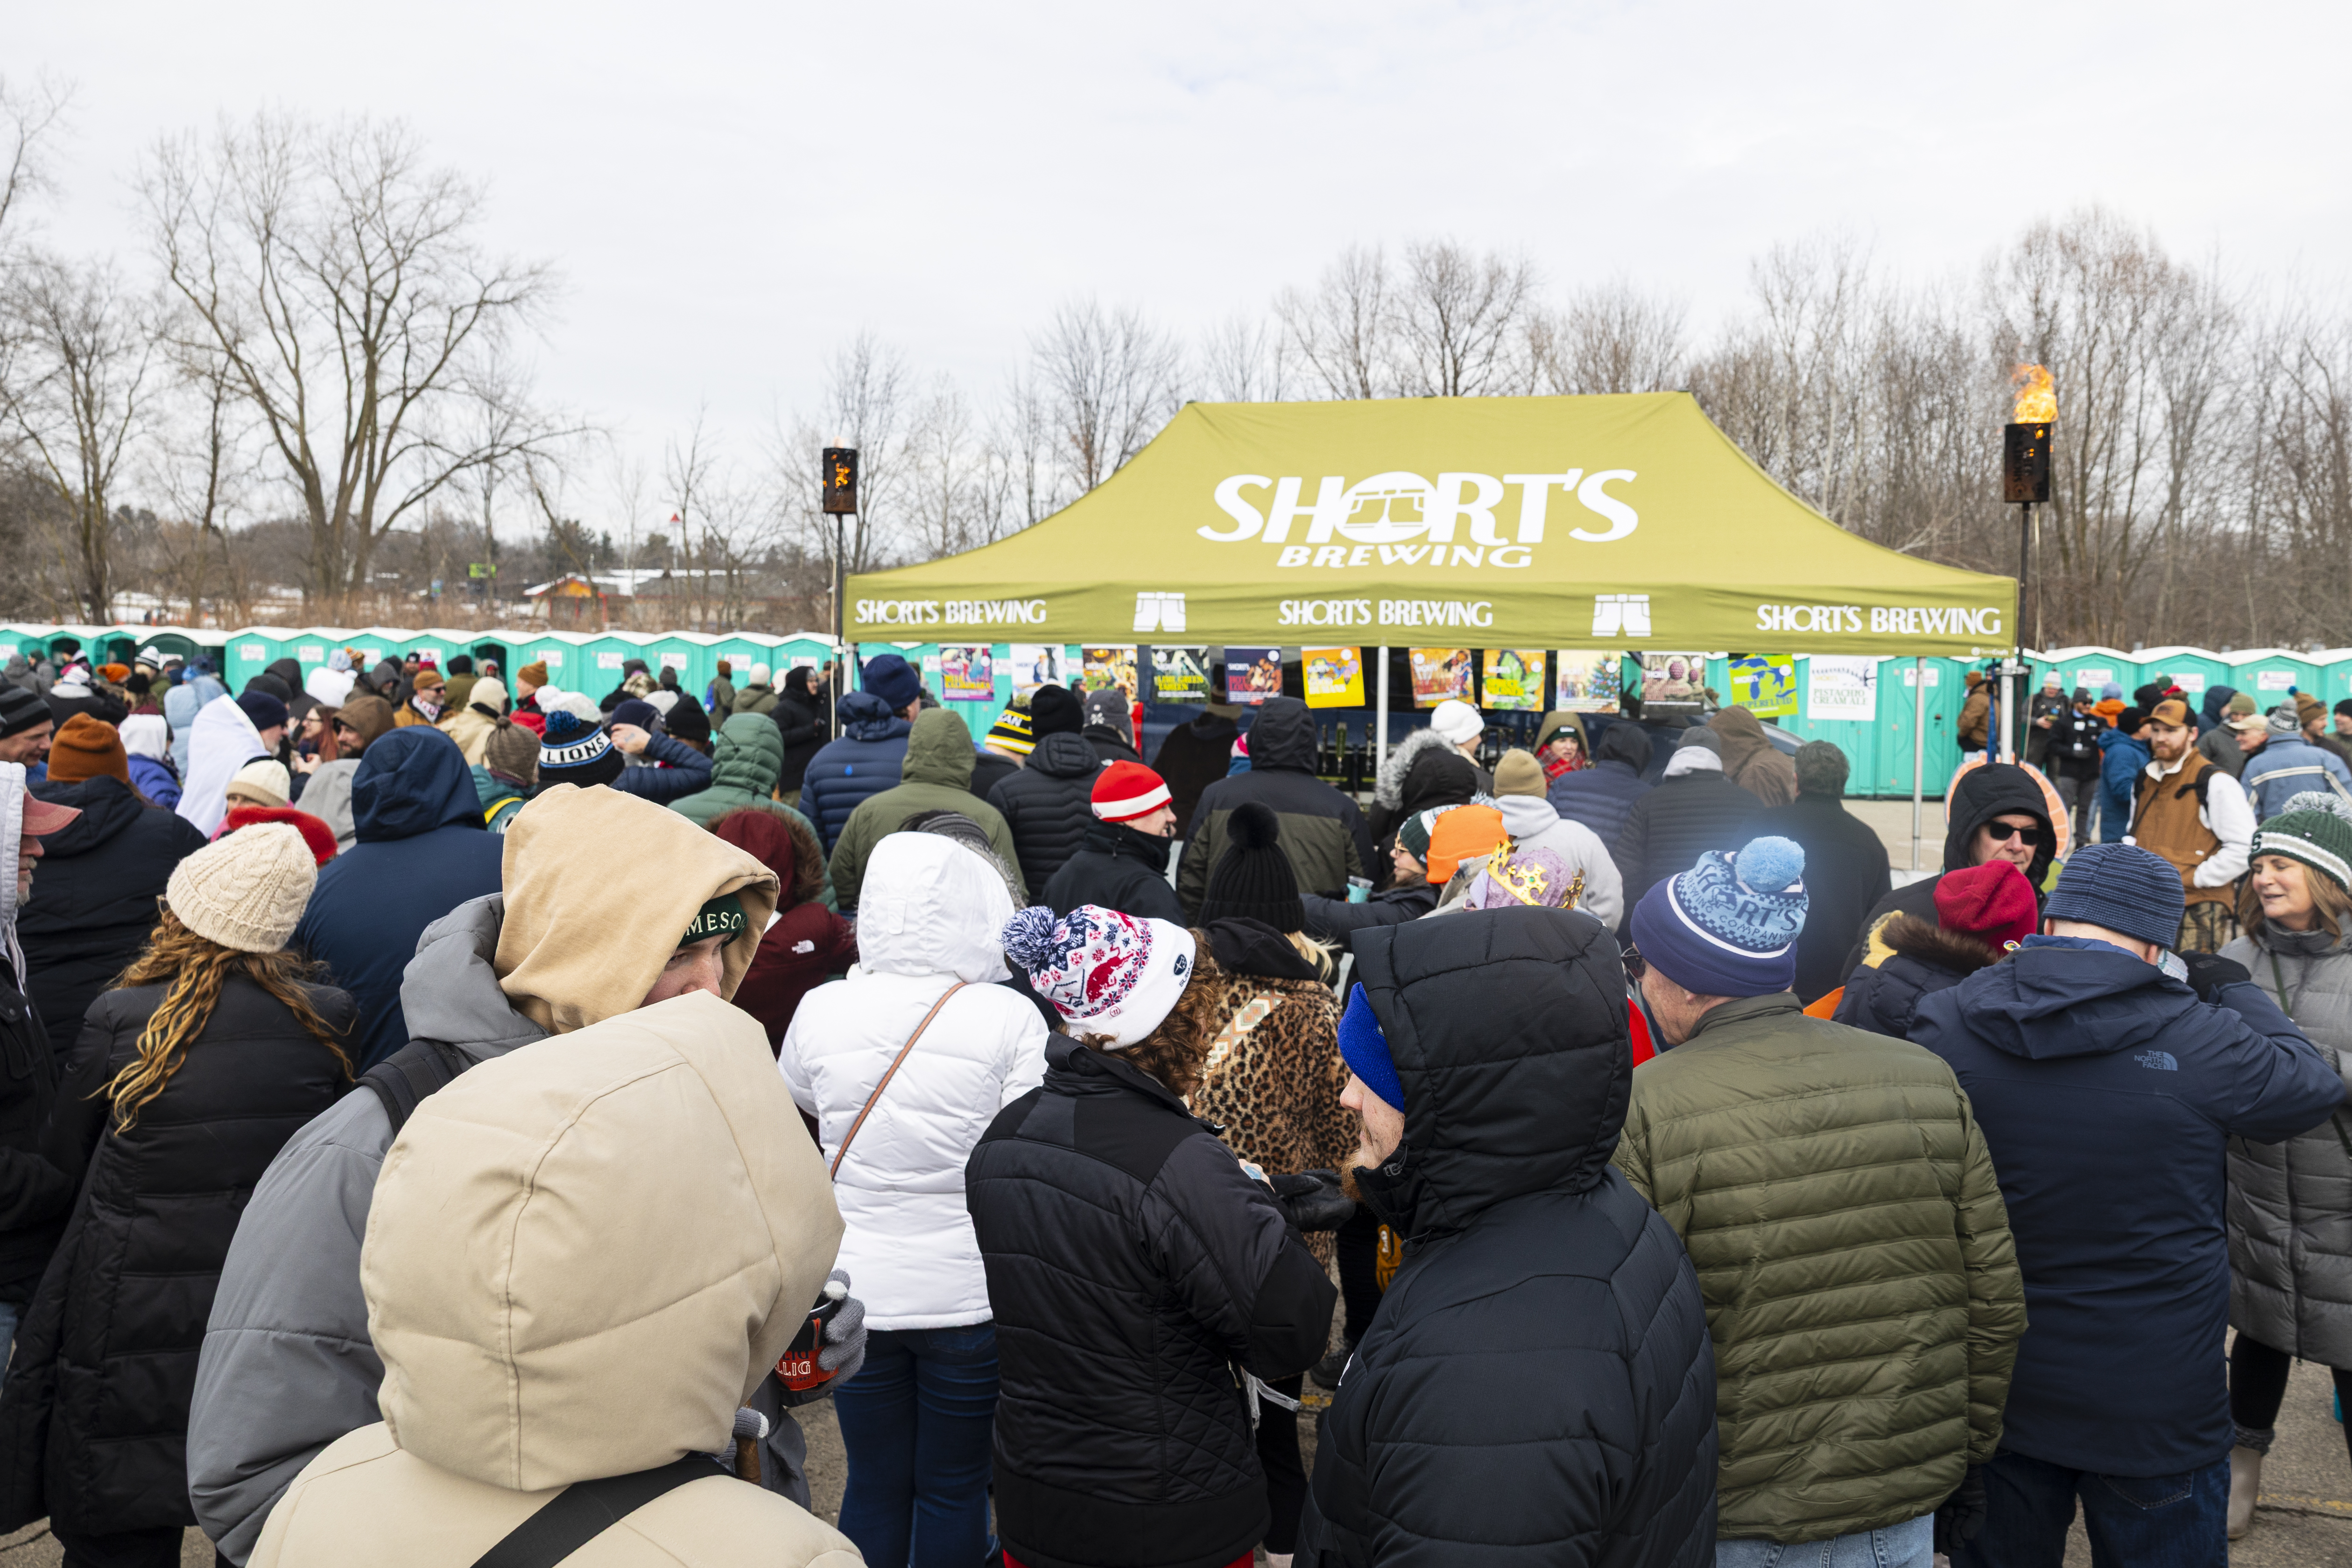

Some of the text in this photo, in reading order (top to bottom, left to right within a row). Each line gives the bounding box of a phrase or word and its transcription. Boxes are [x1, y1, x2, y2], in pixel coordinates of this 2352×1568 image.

[1196, 468, 1639, 546] SHORT'S
[1276, 544, 1533, 568] BREWING
[855, 599, 1047, 624] SHORT'S BREWING
[1278, 598, 1493, 627] SHORT'S BREWING
[1756, 604, 2001, 635] SHORT'S BREWING
[1812, 696, 1868, 706] CREAM ALE
[1814, 688, 1865, 697] PISTACHIO
[547, 737, 605, 764] LIONS
[2134, 1055, 2163, 1063] NORTH
